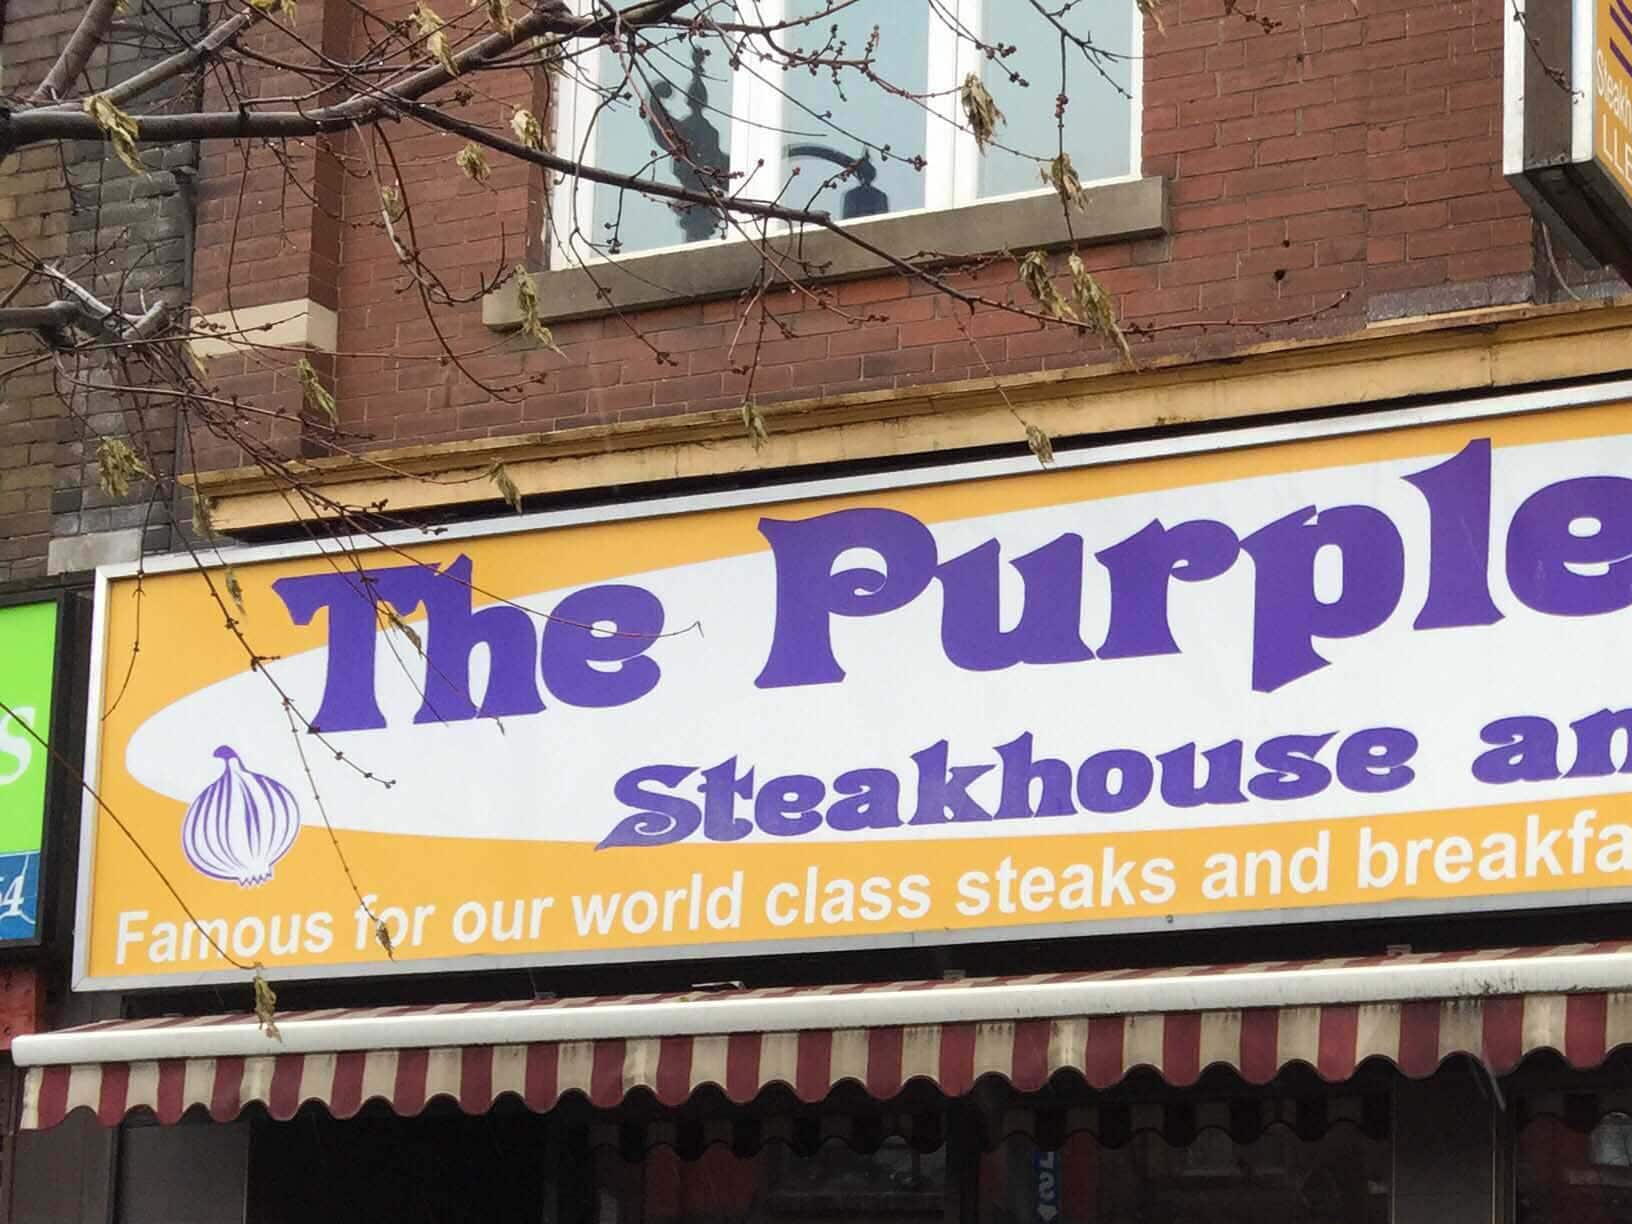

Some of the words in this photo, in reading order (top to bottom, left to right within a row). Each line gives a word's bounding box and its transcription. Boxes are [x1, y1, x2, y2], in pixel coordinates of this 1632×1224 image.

[272, 553, 664, 734] The
[597, 727, 1419, 847] Steakhouse
[116, 909, 334, 965] Famous
[354, 893, 435, 950] for
[452, 896, 554, 944] our
[572, 870, 744, 937] world
[766, 866, 931, 926] class
[956, 847, 1176, 916] steaks
[1201, 830, 1330, 900] and
